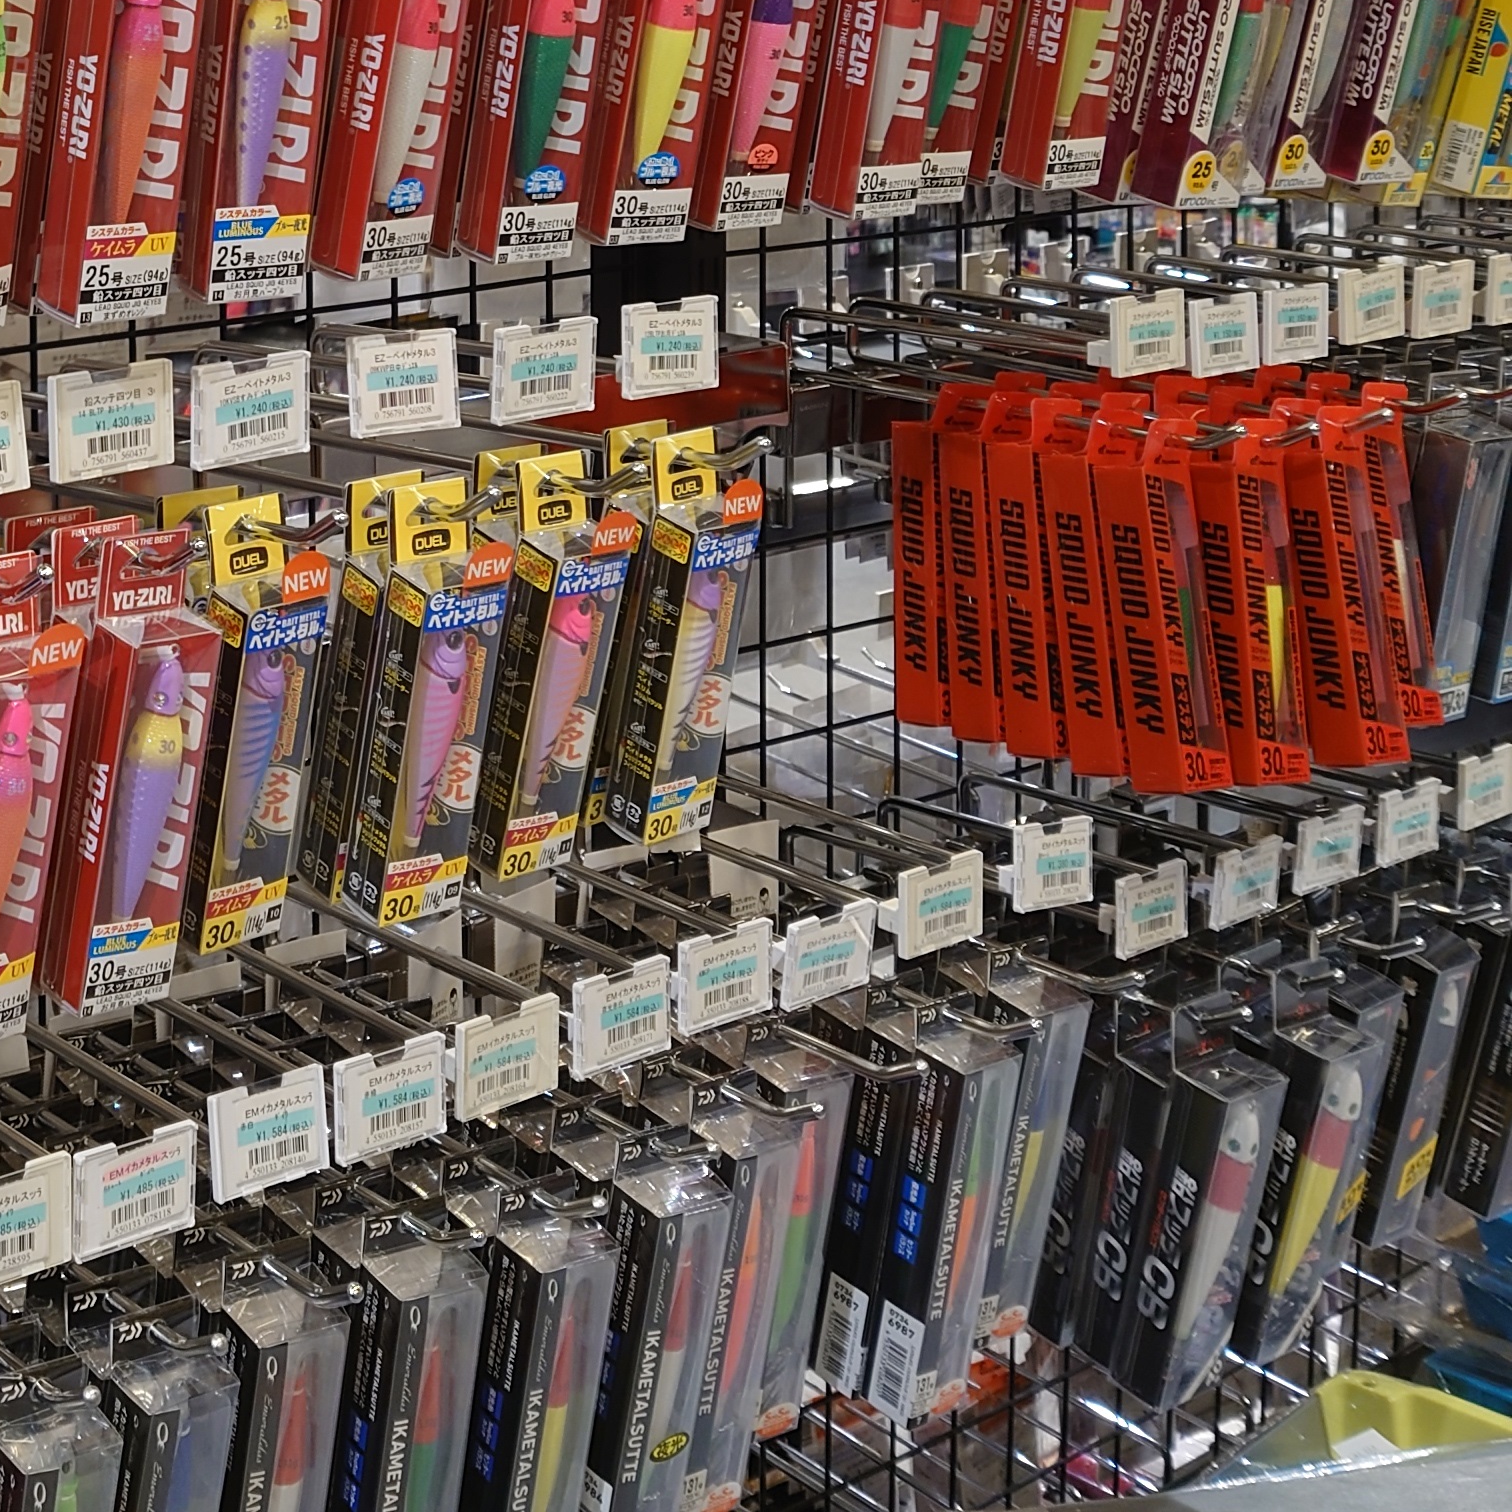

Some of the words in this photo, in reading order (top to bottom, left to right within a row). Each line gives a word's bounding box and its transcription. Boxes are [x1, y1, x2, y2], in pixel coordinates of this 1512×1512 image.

[1480, 7, 1496, 37] RISE
[1466, 39, 1488, 76] JAPAN
[350, 34, 386, 133] YO-ZURI
[1192, 161, 1212, 178] 25
[415, 533, 449, 551] DUEL
[999, 498, 1031, 589] SQUID
[231, 552, 266, 570] DUEL
[468, 557, 512, 580] NEW
[1111, 523, 1151, 620] SQUID
[286, 569, 326, 594] NEW
[428, 606, 503, 629] ベイトメタル
[31, 639, 83, 665] NEW
[1006, 593, 1038, 702] JUNKY
[1123, 622, 1165, 736] JUNKY
[1260, 745, 1283, 776] 30
[926, 1177, 964, 1322] IKAMETALSUTTE
[622, 1328, 662, 1484] IKAMETALSUTTE
